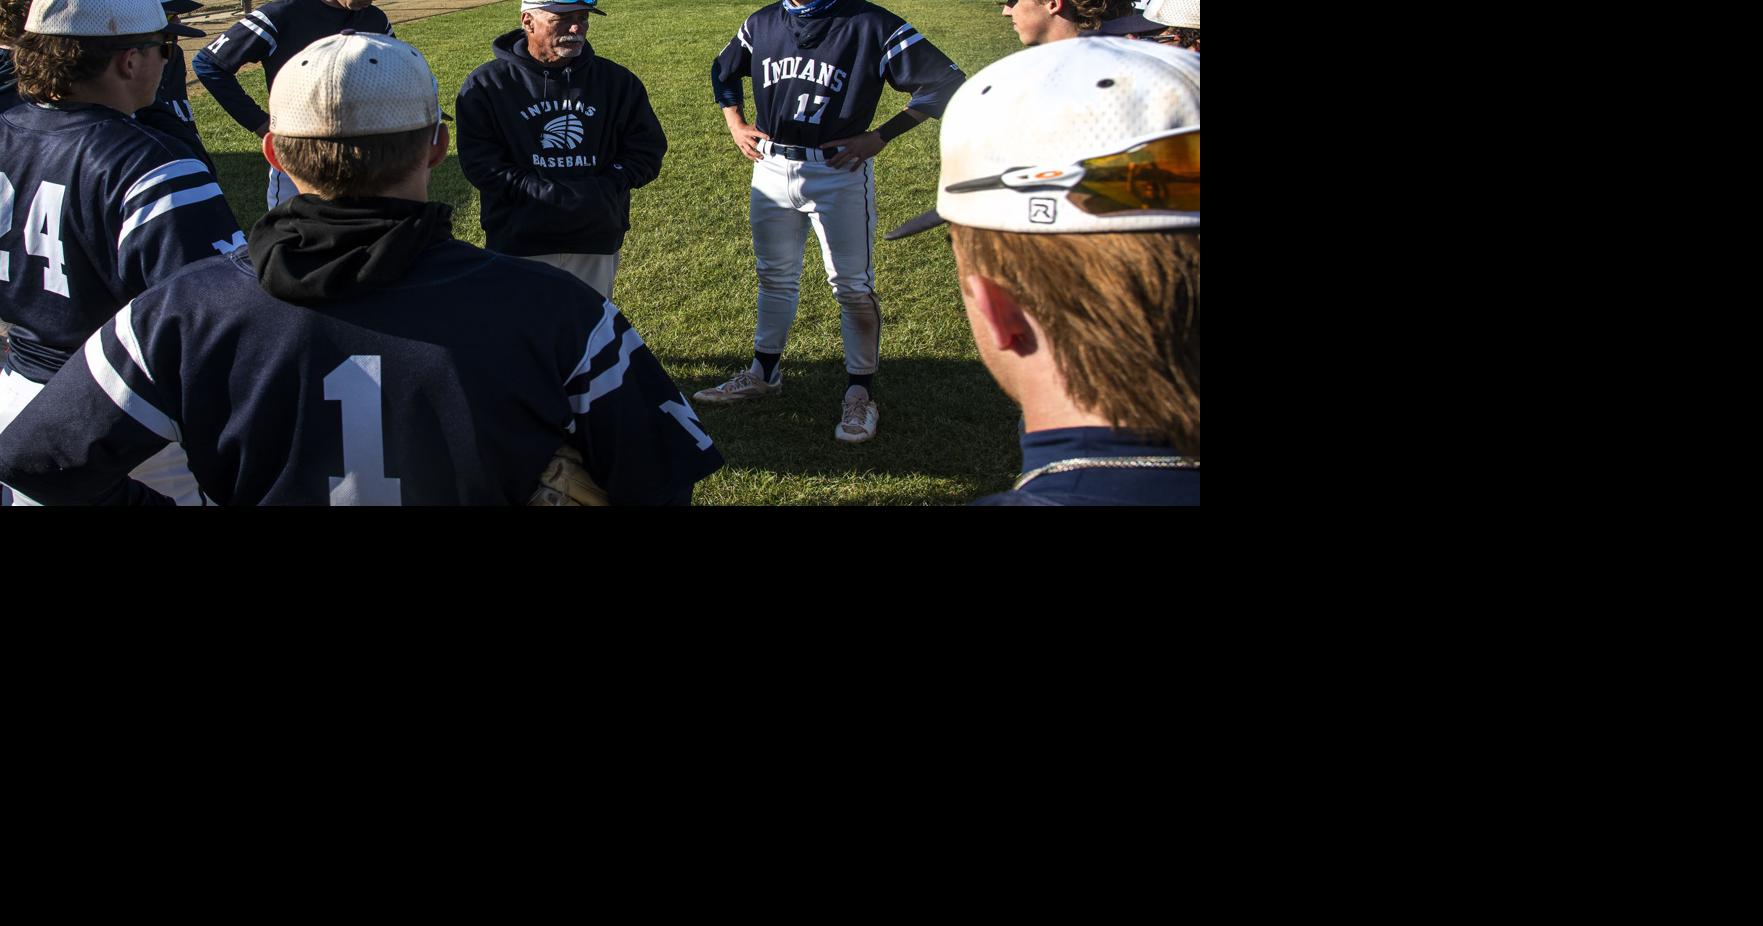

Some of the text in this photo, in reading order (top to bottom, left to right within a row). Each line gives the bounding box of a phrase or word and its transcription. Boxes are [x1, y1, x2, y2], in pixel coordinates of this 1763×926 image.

[762, 56, 847, 93] INDIANS
[520, 99, 597, 120] INDIANS
[793, 93, 831, 125] 17
[323, 355, 402, 506] 1
